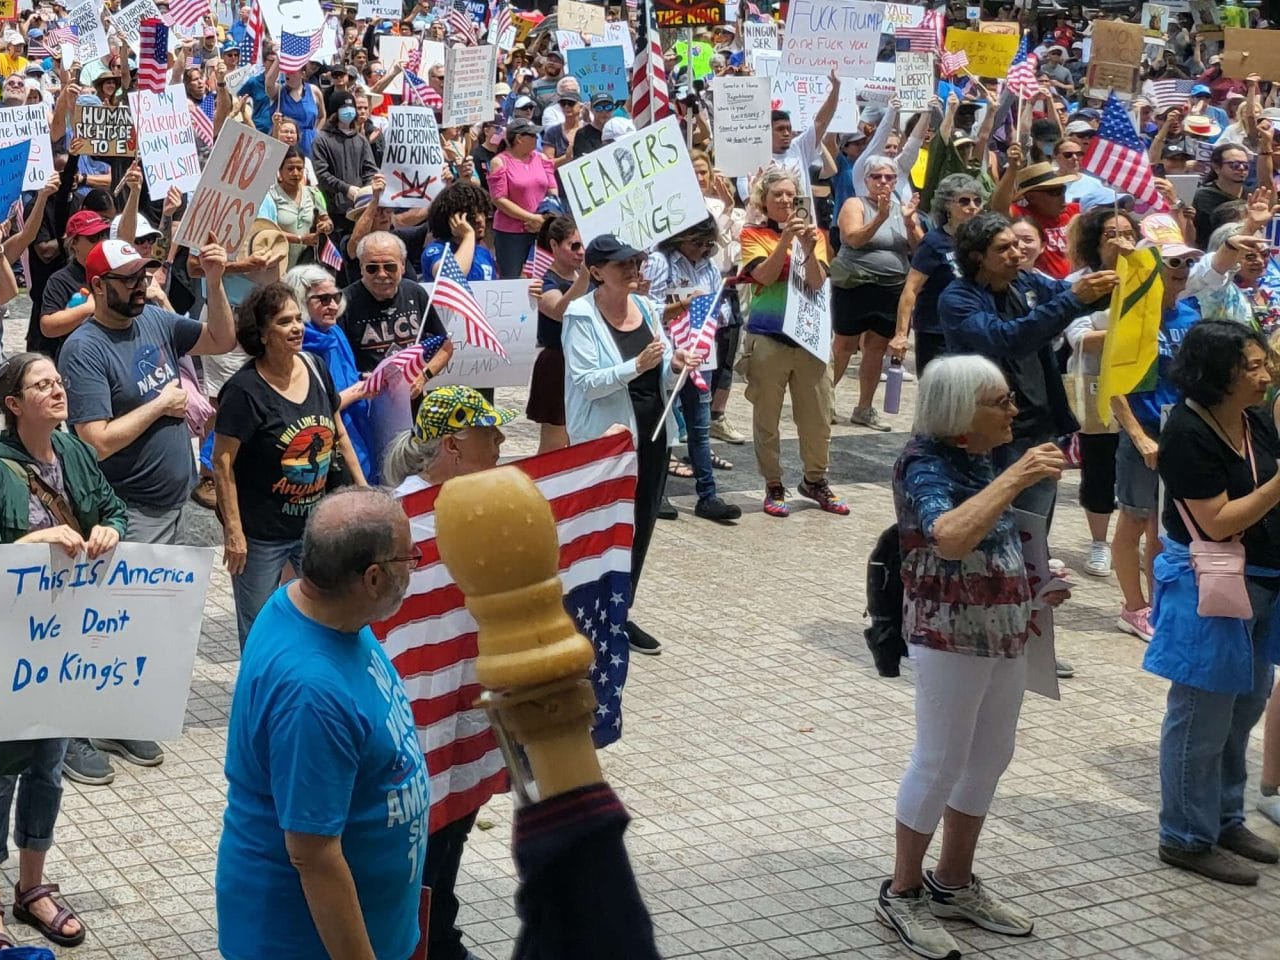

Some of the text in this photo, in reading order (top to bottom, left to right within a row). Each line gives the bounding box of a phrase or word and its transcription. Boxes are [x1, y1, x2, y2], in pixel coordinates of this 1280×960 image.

[656, 7, 720, 25] THE KING
[791, 0, 884, 34] FUCK TRUMP
[746, 26, 777, 38] NINGUN
[752, 38, 771, 48] SER
[787, 38, 813, 50] and
[901, 73, 932, 88] LIBERTY
[158, 90, 174, 109] My
[81, 106, 134, 126] HUMAN
[391, 112, 436, 129] NO THRONES
[31, 121, 50, 136] the
[76, 123, 118, 139] RIGHTS
[390, 129, 439, 145] NO CROWNS
[91, 140, 109, 154] TO
[142, 136, 170, 157] Duty
[386, 145, 442, 166] NO KINGS
[145, 153, 200, 187] BULLSHIT
[221, 131, 267, 190] NO
[567, 125, 679, 217] LEADERS
[28, 167, 45, 182] do
[619, 181, 655, 222] NOT
[183, 187, 254, 254] KINGS
[485, 290, 513, 318] BE
[360, 315, 419, 345] ALCS
[459, 358, 499, 377] LAND
[137, 363, 176, 396] NASA
[280, 424, 300, 446] WILL
[296, 415, 318, 429] LINE
[7, 565, 70, 596] This
[108, 560, 194, 586] America
[29, 608, 130, 641] We Don't
[12, 658, 49, 692] Do
